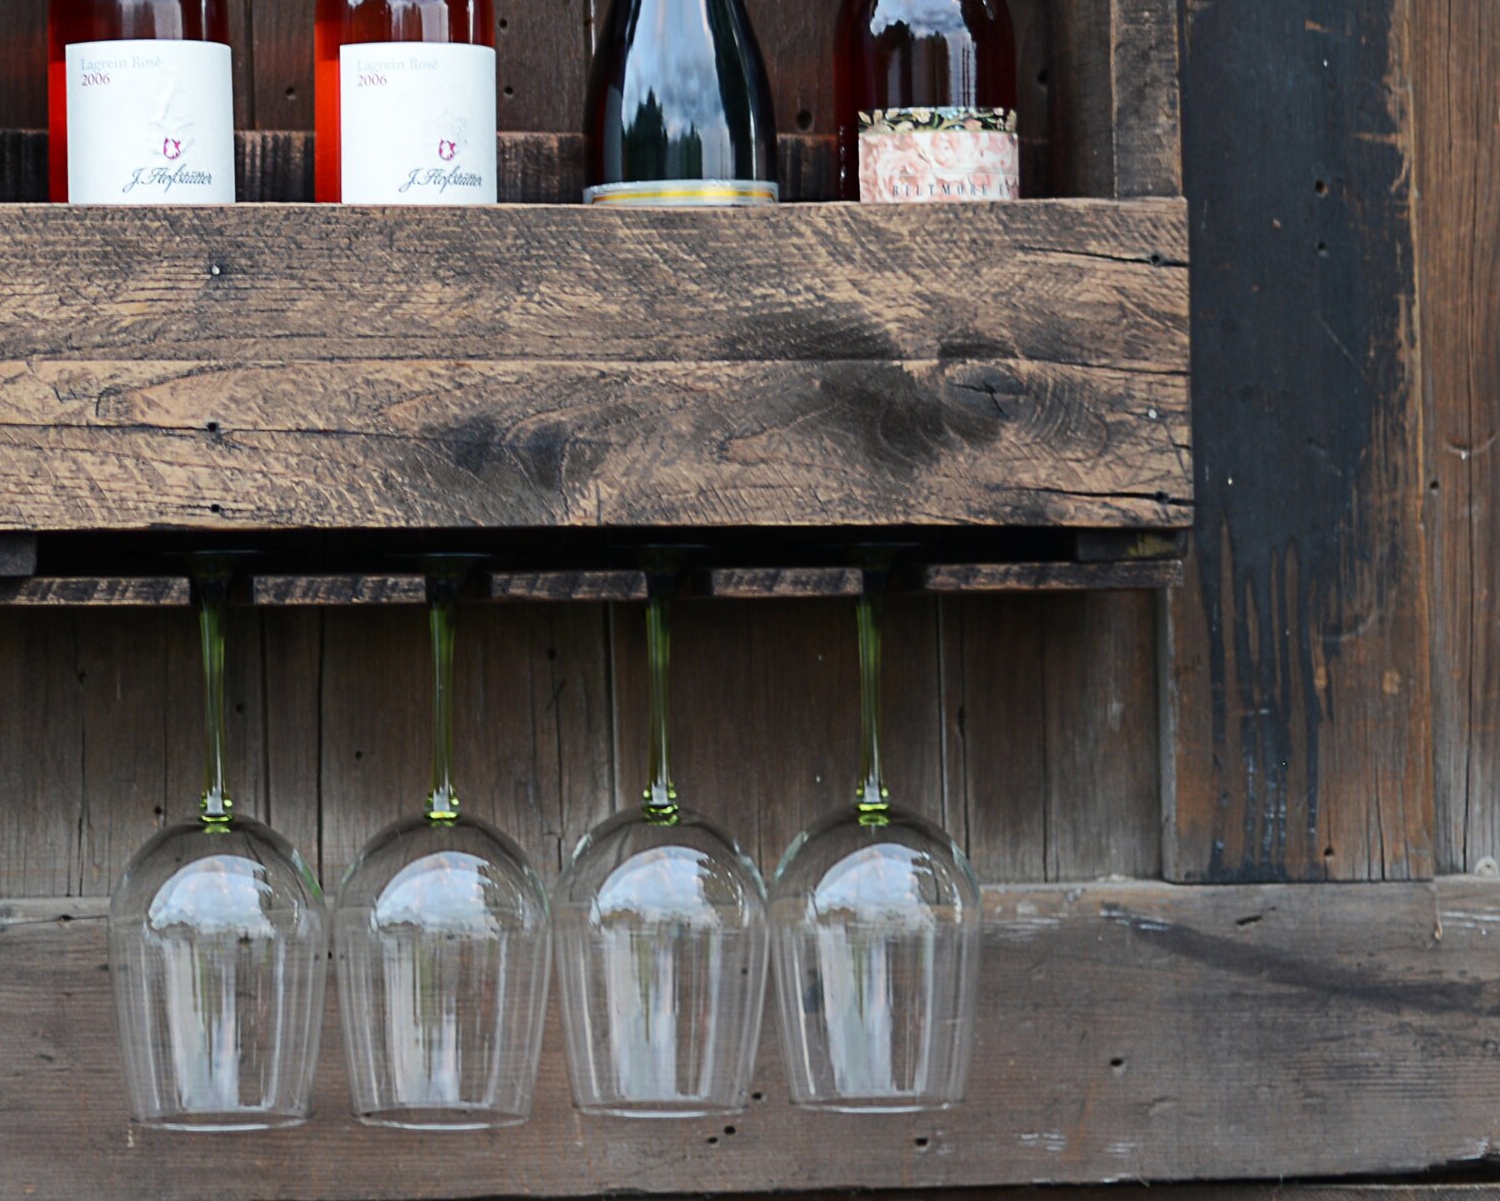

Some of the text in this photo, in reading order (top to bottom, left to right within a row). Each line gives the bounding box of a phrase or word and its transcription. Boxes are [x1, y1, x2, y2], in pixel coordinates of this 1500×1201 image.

[81, 71, 110, 87] 2006
[357, 73, 388, 87] 2006
[892, 183, 988, 197] BILTMORE
